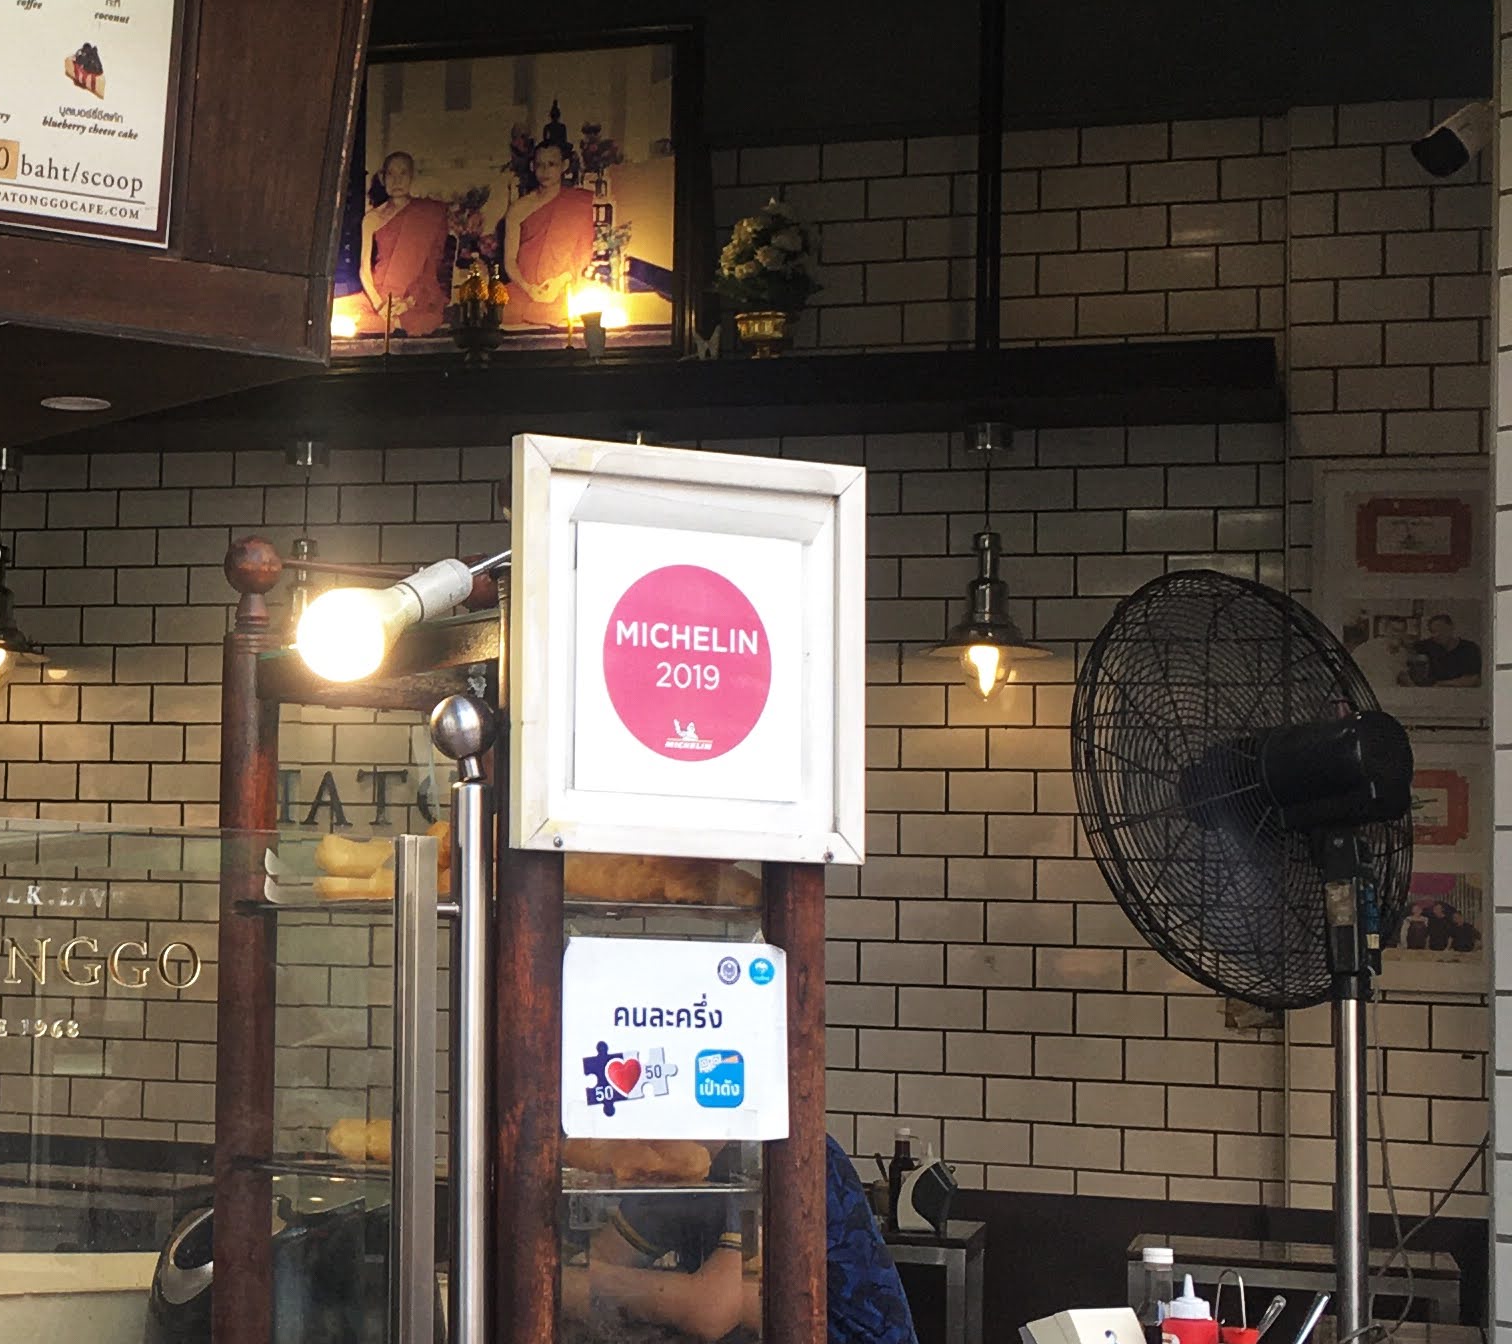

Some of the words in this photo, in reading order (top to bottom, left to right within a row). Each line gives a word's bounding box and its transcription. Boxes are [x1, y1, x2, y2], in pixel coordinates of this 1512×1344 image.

[94, 10, 130, 25] coconut
[42, 115, 87, 135] blueberry
[88, 123, 117, 137] cheese
[117, 128, 139, 140] cake
[20, 152, 144, 198] baht/scoop
[616, 619, 758, 655] MICHELIN
[656, 661, 720, 691] 2019
[614, 993, 724, 1029] คนละครึ่ง
[20, 1018, 81, 1039] 1968
[595, 1086, 615, 1102] 50
[645, 1064, 663, 1080] 50
